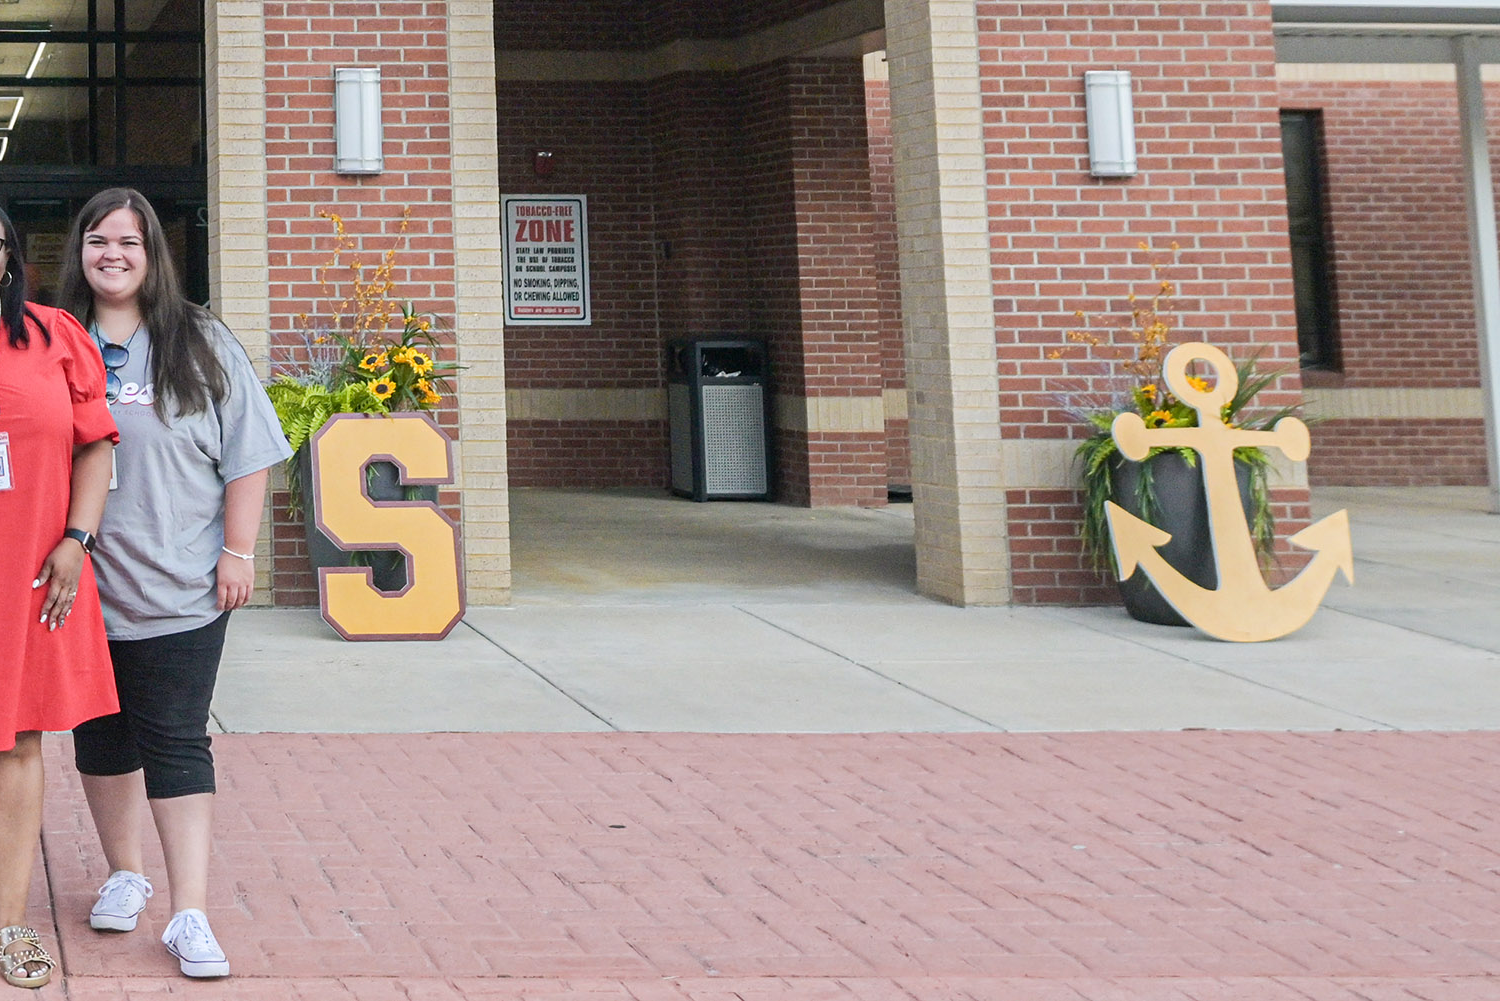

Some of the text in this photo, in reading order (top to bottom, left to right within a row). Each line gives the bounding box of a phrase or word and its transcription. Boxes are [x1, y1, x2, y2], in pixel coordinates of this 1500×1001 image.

[515, 205, 573, 217] TOBACCO-FREE
[515, 219, 575, 243] ZONE
[515, 247, 575, 255] STATE LAW PROHIBITS
[513, 278, 580, 290] NO SMOKING, DIPPING,
[513, 291, 580, 302] OR CHEWING ALLOWED
[310, 412, 467, 642] S
